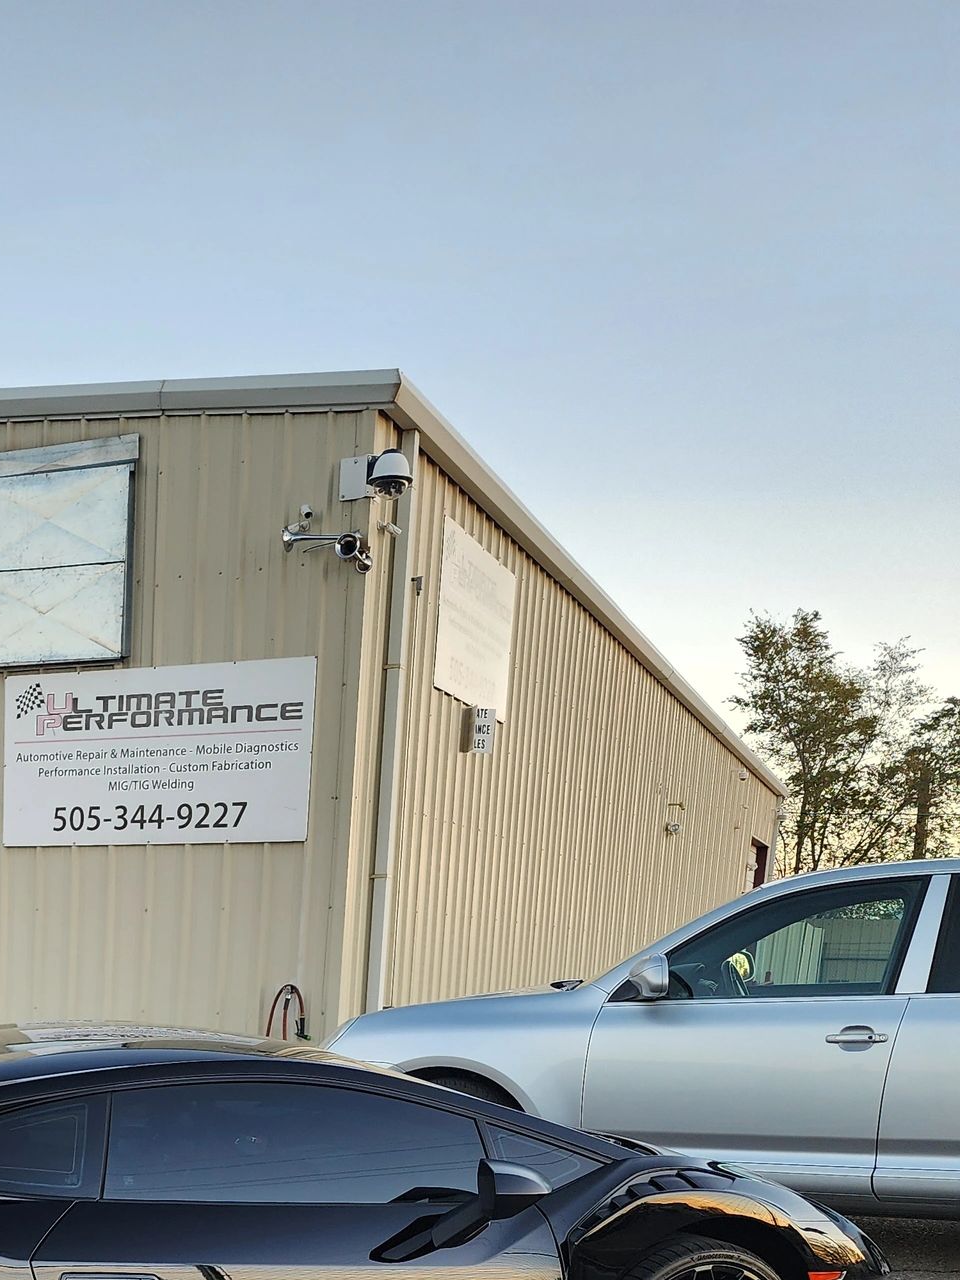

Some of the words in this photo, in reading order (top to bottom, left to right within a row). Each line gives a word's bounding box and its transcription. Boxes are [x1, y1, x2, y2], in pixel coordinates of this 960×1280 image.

[47, 689, 224, 715] ULTIMATE
[36, 702, 303, 736] PERFORMANCE
[16, 751, 73, 762] Automotive
[76, 749, 108, 762] Repair
[111, 749, 117, 759] &
[121, 747, 186, 758] Maintenance
[196, 744, 232, 755] Mobile
[236, 741, 299, 755] Diagnostics
[38, 766, 101, 777] Performance
[103, 763, 160, 775] Installation
[169, 762, 208, 773] Custom
[212, 759, 271, 771] Fabrication
[108, 780, 150, 792] MIG/TIG
[152, 778, 194, 791] Welding
[53, 802, 247, 832] 505-344-9227
